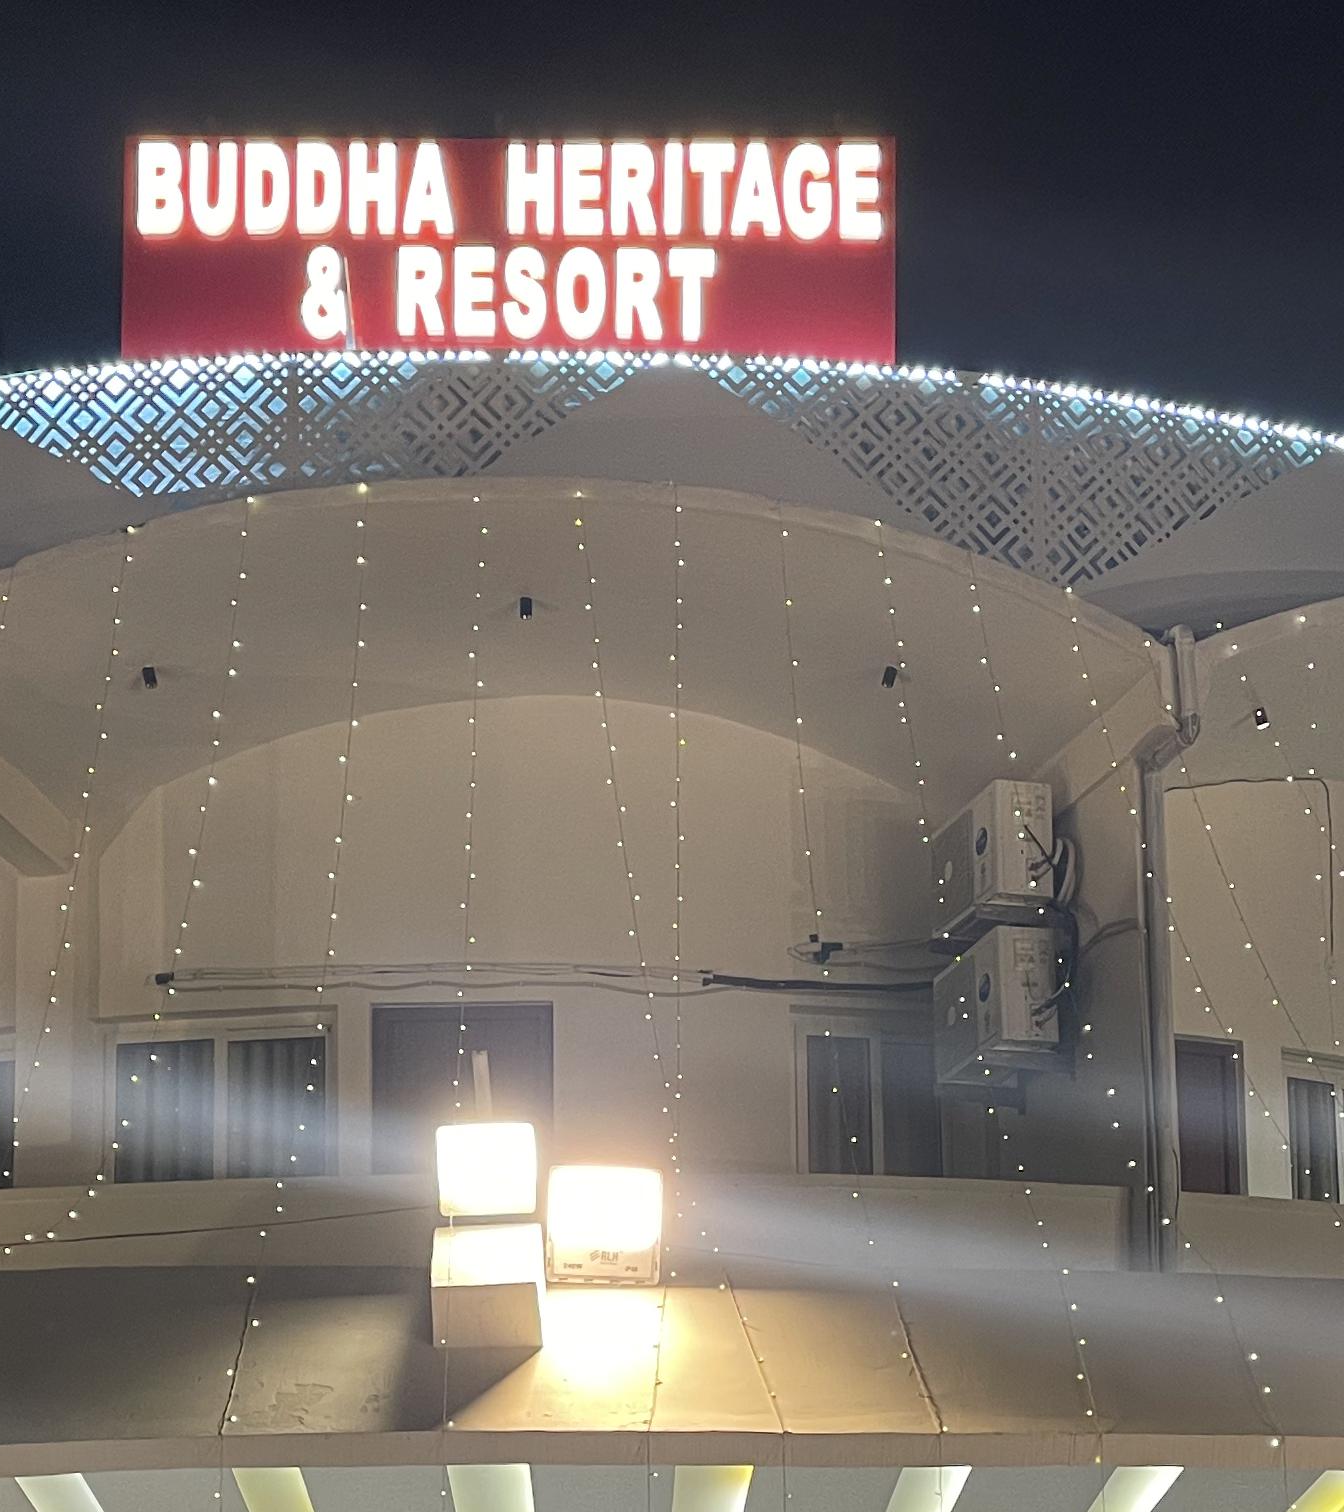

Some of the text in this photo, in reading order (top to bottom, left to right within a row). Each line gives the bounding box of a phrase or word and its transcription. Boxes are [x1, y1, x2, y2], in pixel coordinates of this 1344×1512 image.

[135, 141, 885, 241] BUDDHA HERITAGE
[299, 243, 717, 342] & RESORT
